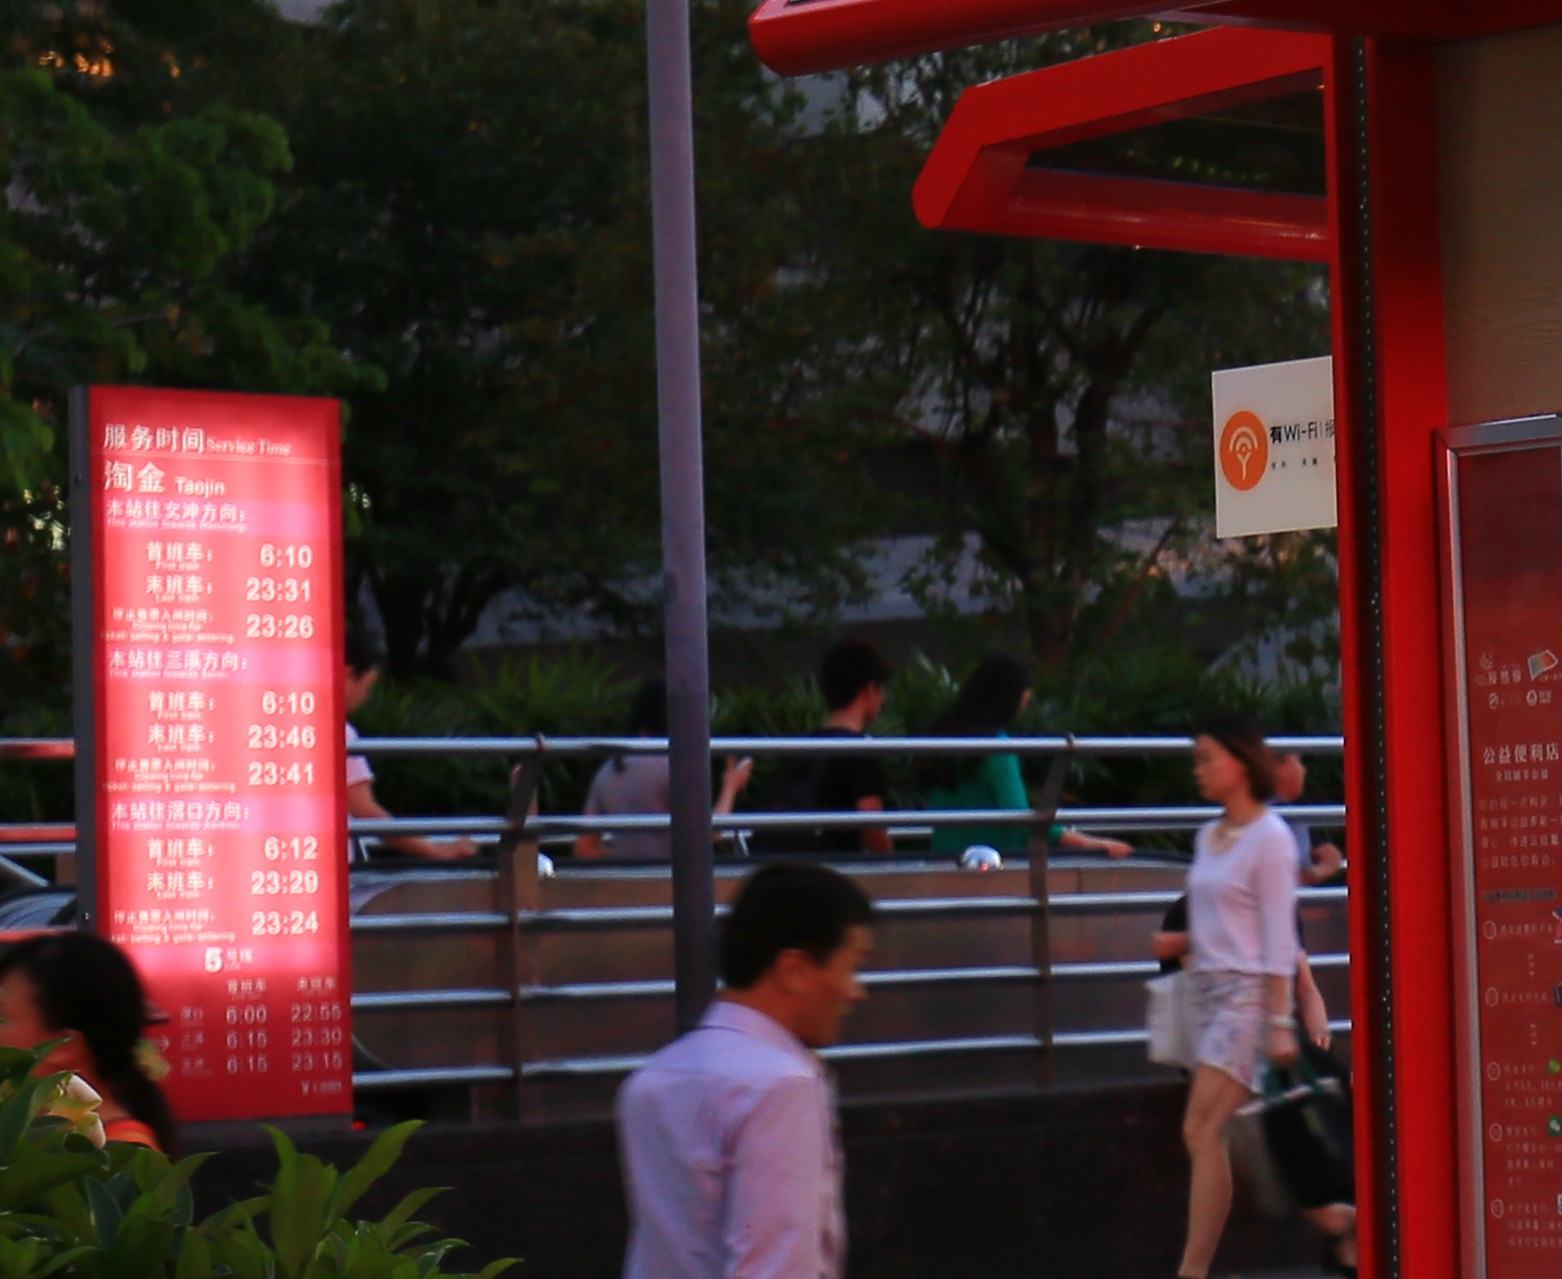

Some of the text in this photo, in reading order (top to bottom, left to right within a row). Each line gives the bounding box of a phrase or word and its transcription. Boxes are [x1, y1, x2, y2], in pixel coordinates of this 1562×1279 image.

[103, 423, 206, 454] 服务时间
[104, 460, 226, 500] 淘金 Taojin
[259, 543, 313, 569] 6:10
[245, 576, 312, 602] 23:31
[245, 613, 314, 639] 23:26
[261, 690, 316, 716] 6:10
[247, 724, 316, 749] 23:46
[1483, 743, 1560, 765] 公益便利店
[247, 760, 315, 786] 23:41
[264, 836, 319, 861] 6:12
[250, 870, 320, 896] 23:29
[251, 911, 320, 936] 23:24
